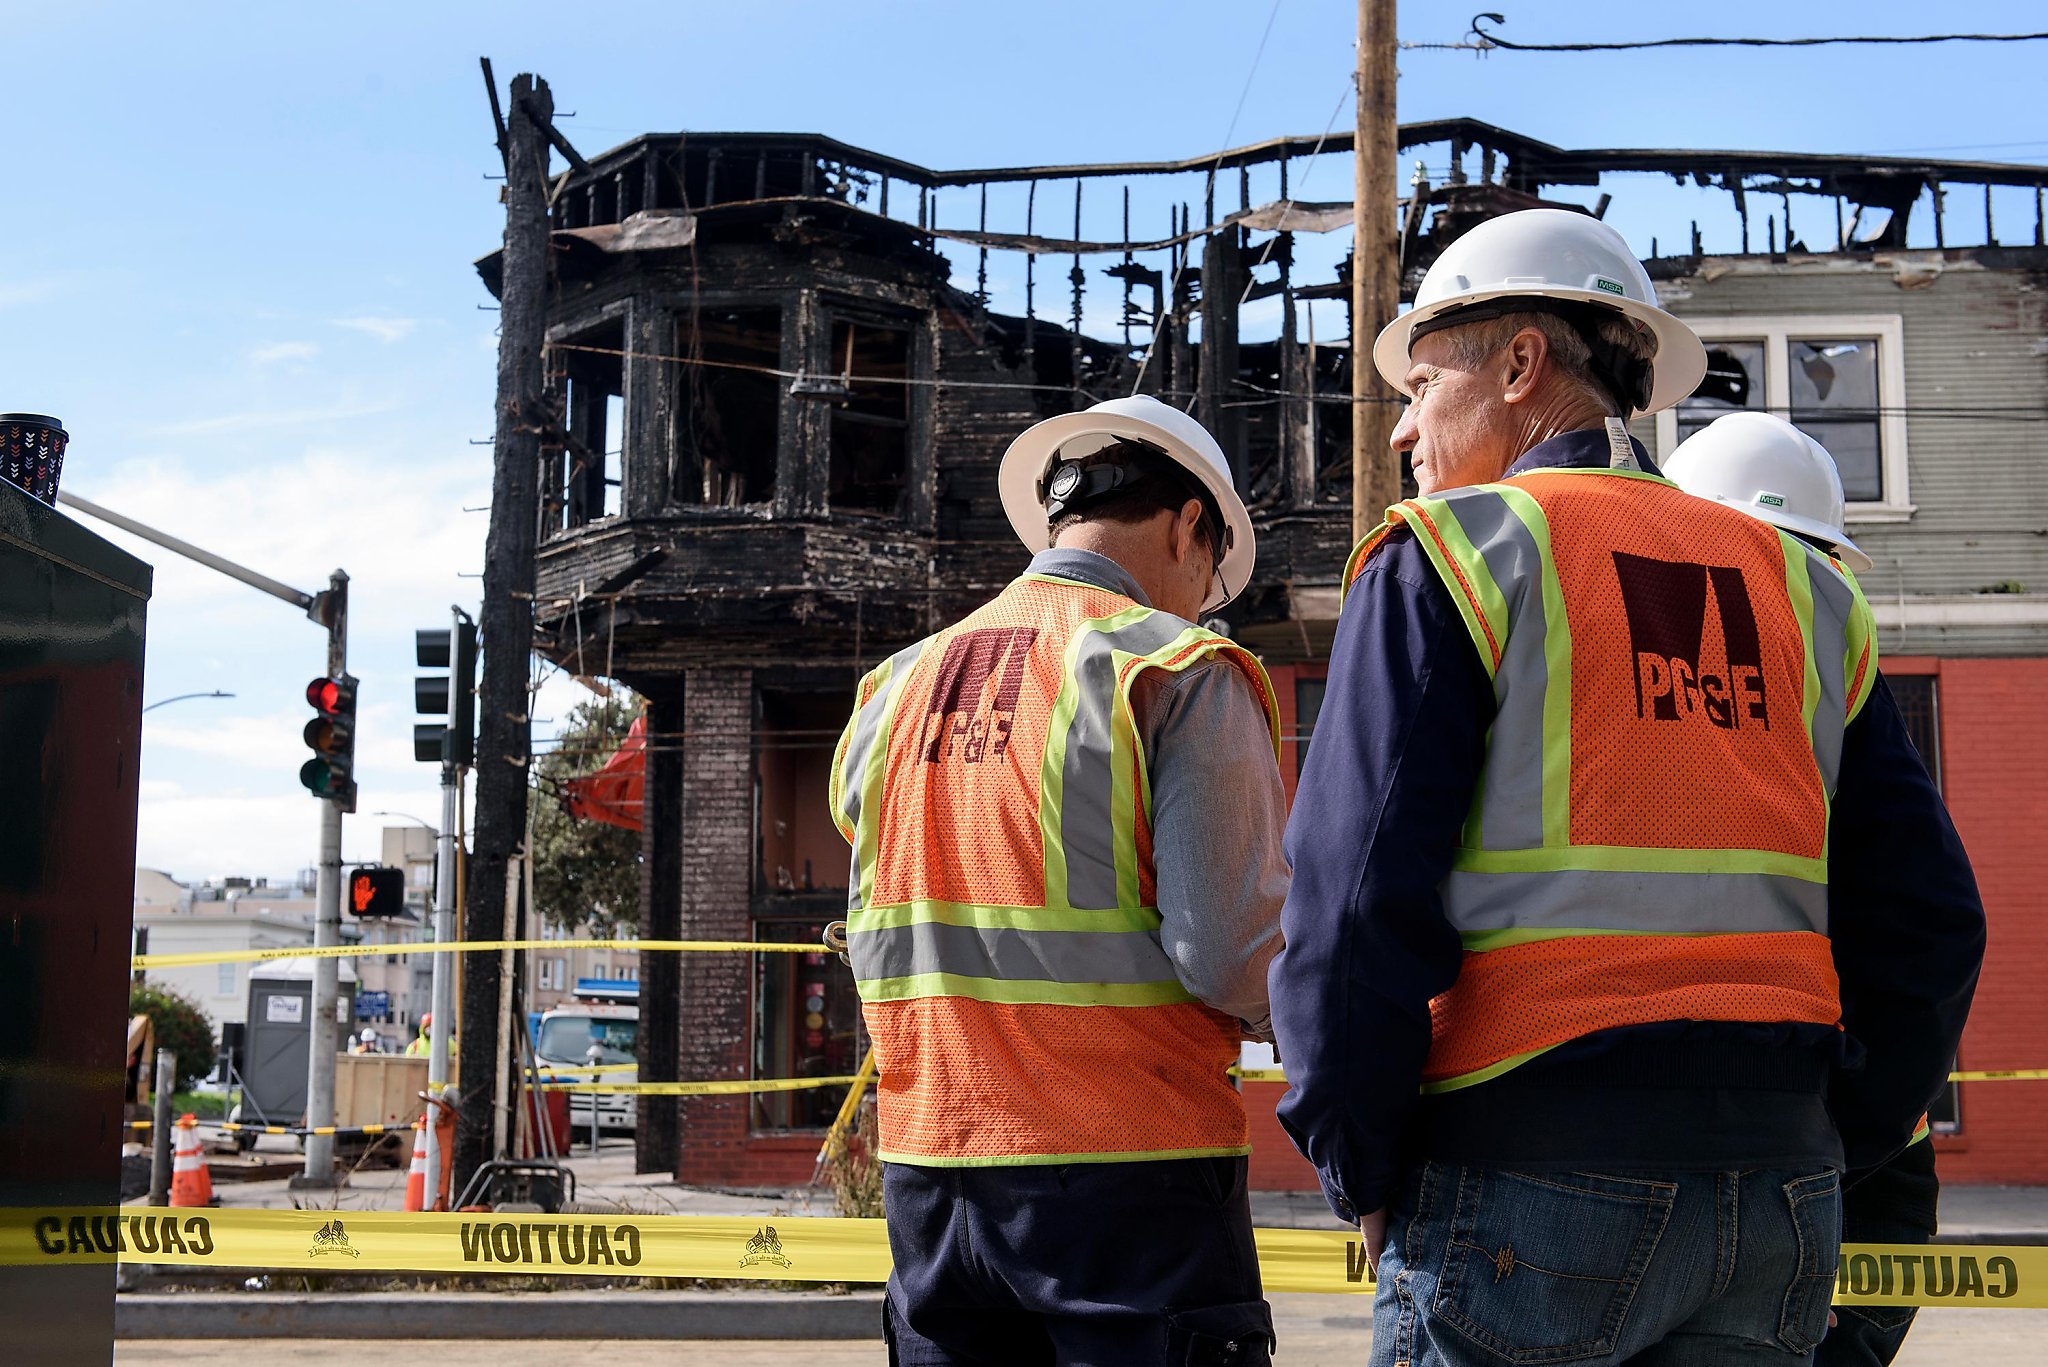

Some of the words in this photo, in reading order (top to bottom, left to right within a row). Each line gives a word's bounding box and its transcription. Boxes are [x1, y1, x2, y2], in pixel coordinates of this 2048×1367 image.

[1599, 280, 1623, 295] MSA
[1760, 495, 1783, 506] MSA
[1634, 652, 1768, 730] PG&E
[918, 711, 1014, 764] PG&E
